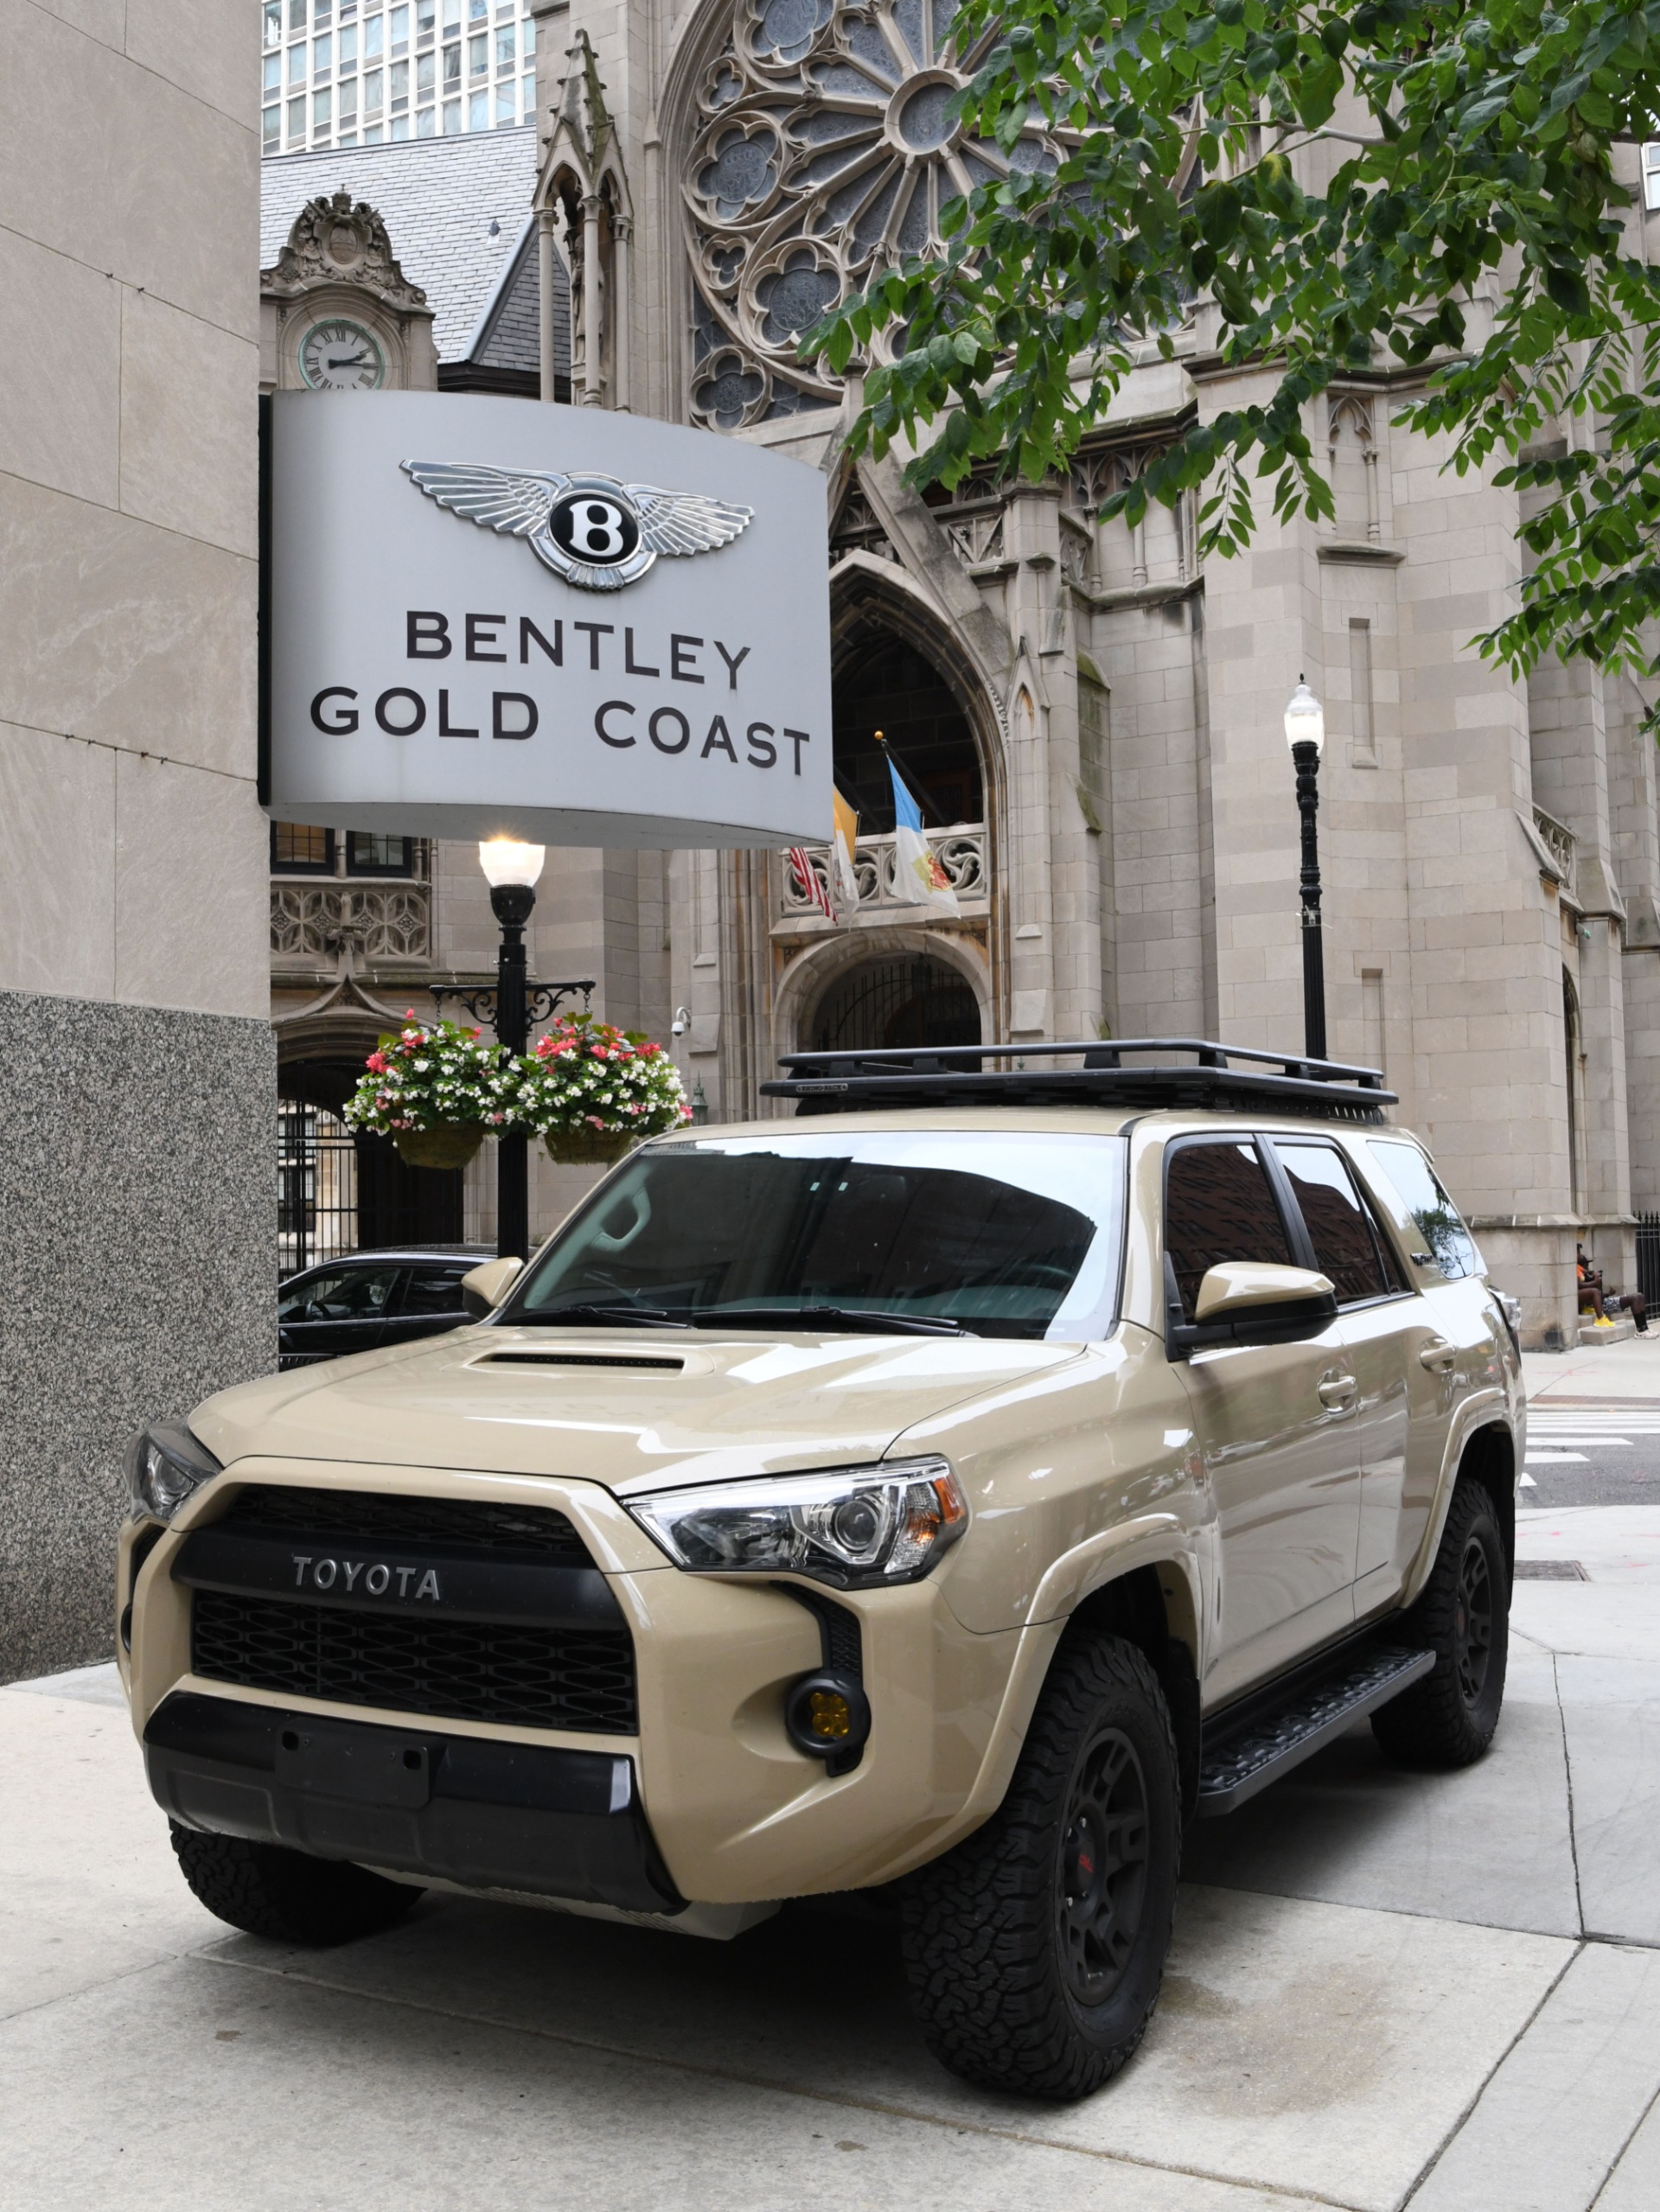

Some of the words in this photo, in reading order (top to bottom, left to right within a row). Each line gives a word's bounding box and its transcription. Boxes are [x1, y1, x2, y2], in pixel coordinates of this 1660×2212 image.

[569, 500, 623, 557] B
[406, 610, 751, 691] BENTLEY
[310, 685, 539, 741] GOLD
[594, 700, 810, 776] COAST
[293, 1556, 440, 1601] TOYOTA
